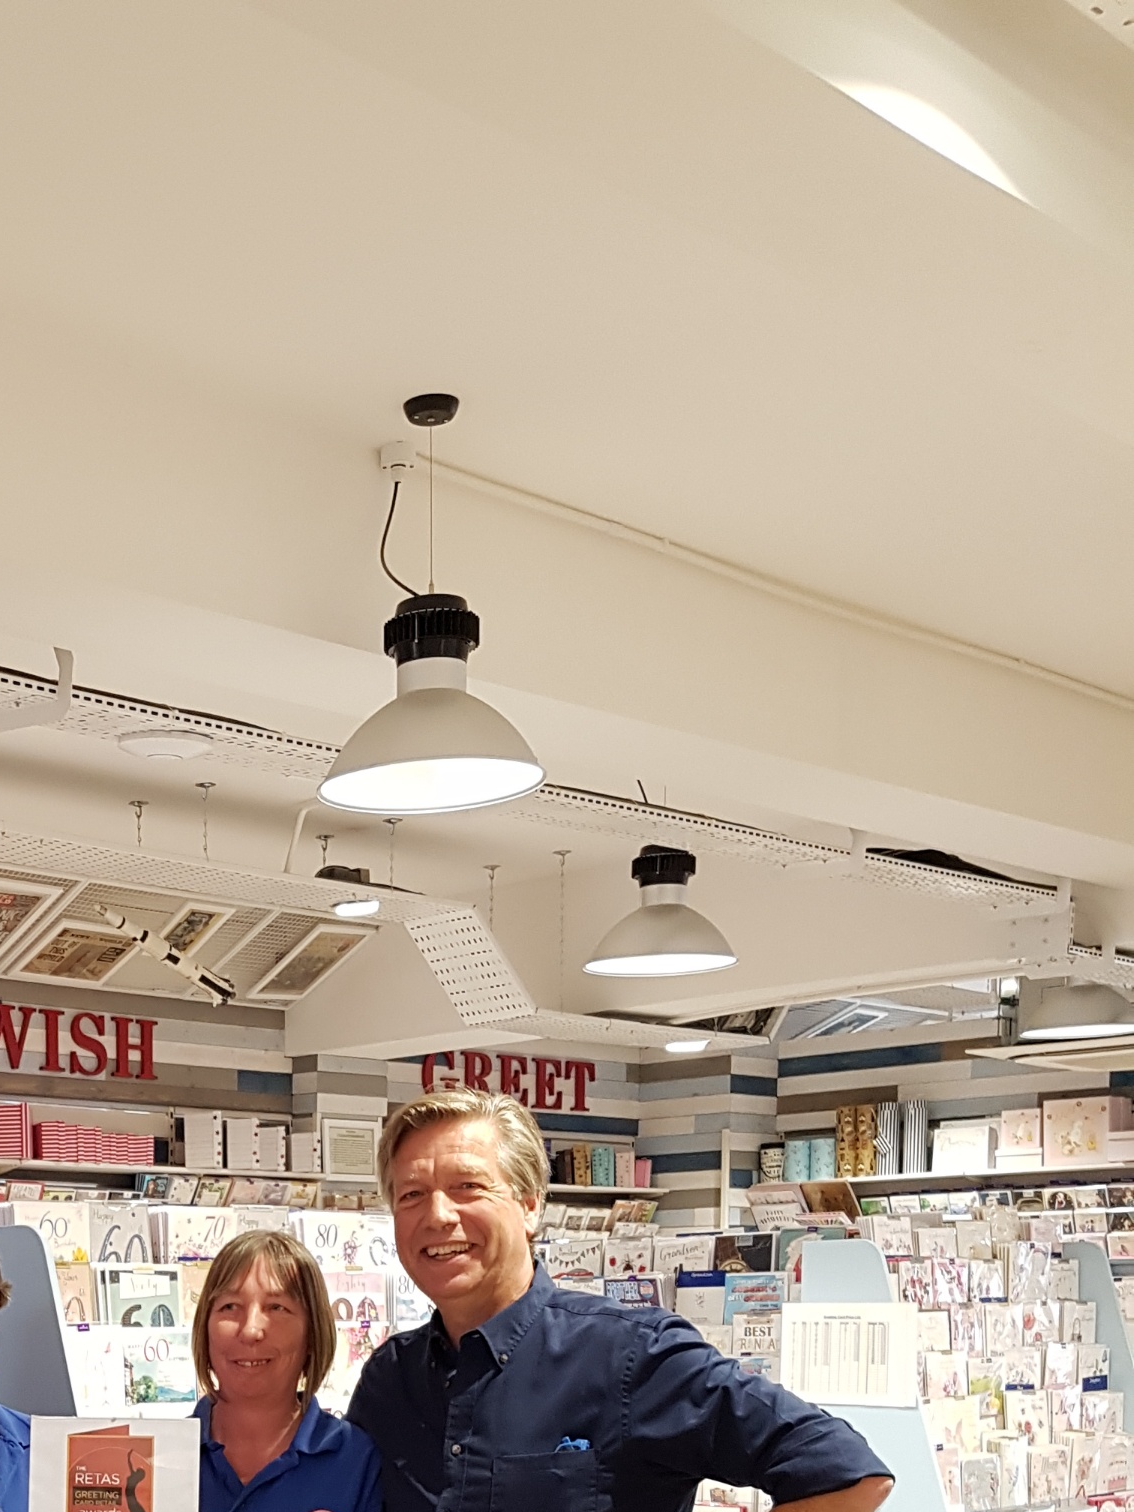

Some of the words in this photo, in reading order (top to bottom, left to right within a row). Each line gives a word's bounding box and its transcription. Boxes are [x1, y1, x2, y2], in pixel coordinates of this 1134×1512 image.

[422, 1050, 596, 1112] GREET
[40, 1210, 68, 1241] 60
[205, 1215, 226, 1243] 70
[315, 1223, 338, 1248] 80
[744, 1326, 774, 1338] BEST
[143, 1336, 170, 1363] 60
[75, 1472, 121, 1485] RETAS
[74, 1490, 120, 1499] GREETING
